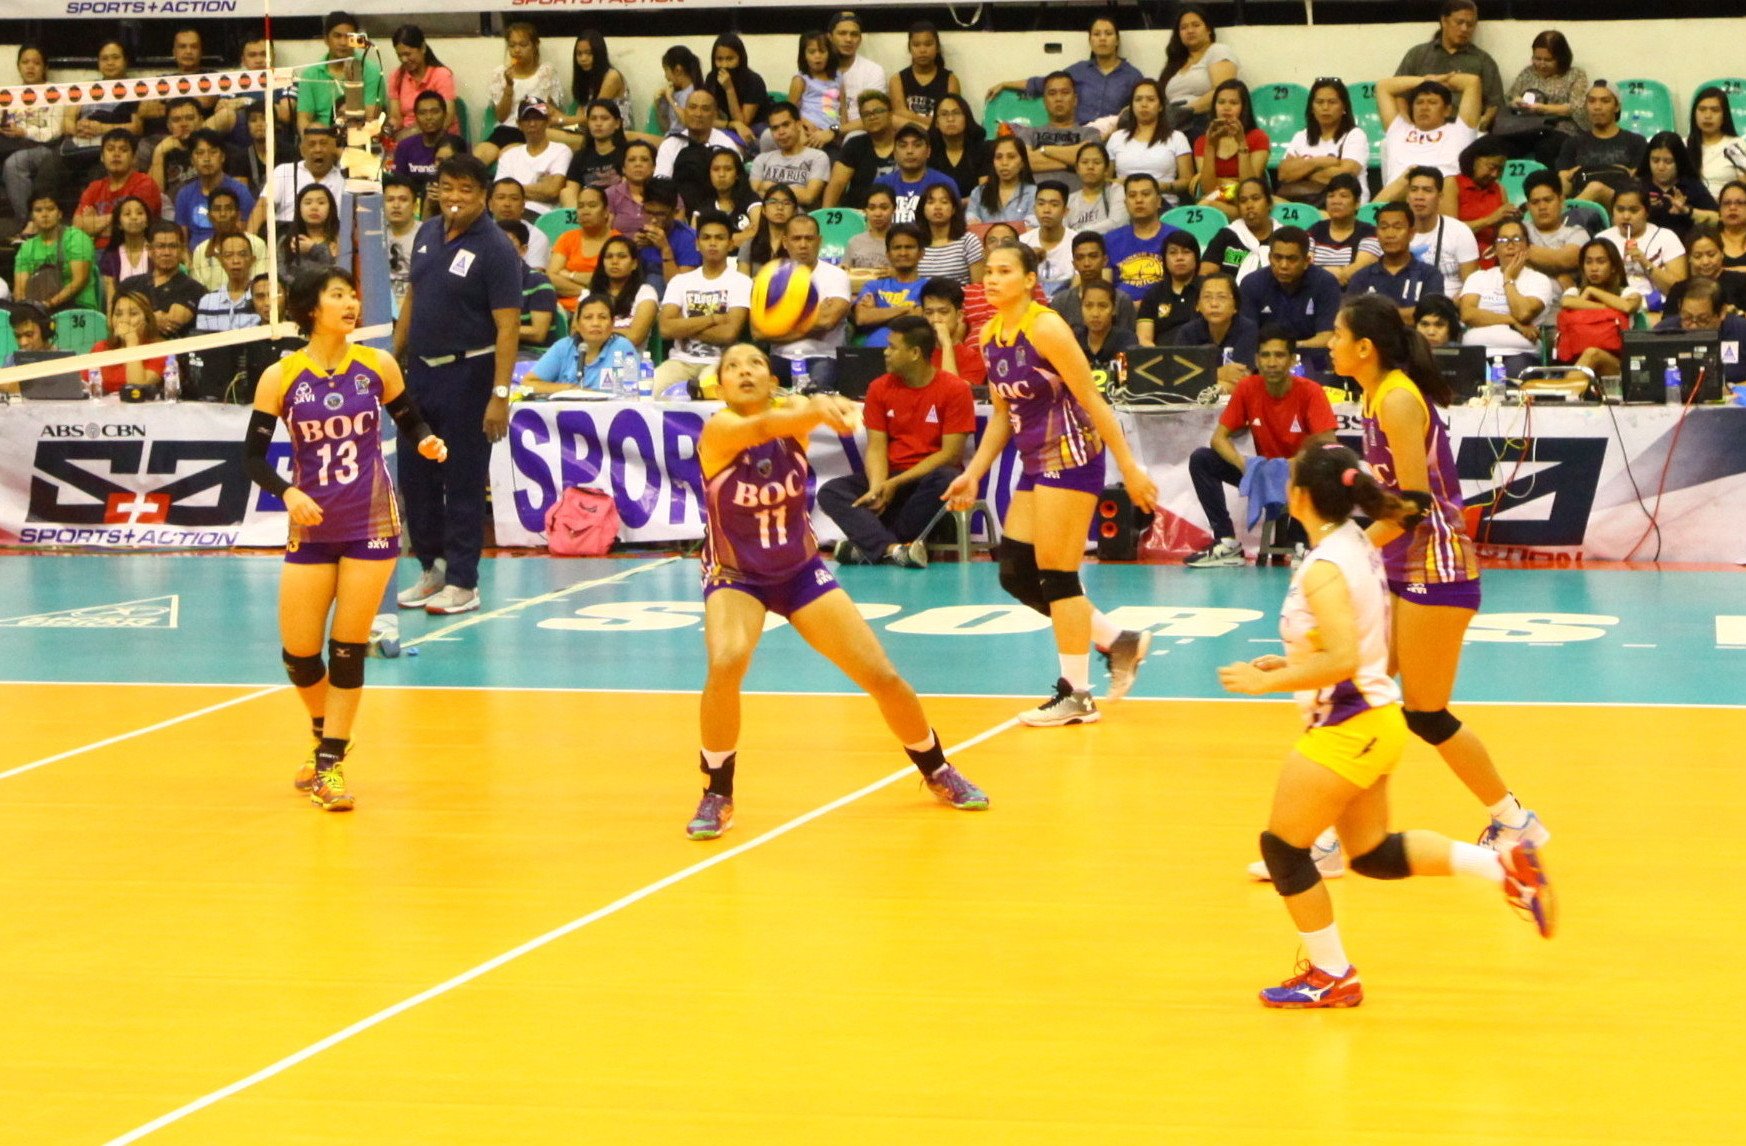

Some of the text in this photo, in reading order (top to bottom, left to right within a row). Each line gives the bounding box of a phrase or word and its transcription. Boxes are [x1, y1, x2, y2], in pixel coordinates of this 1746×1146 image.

[1509, 163, 1525, 176] 22
[826, 211, 843, 225] 29
[1186, 209, 1204, 224] 25
[1282, 207, 1299, 221] 24
[71, 314, 86, 329] 36
[297, 410, 374, 443] BOC
[316, 439, 359, 487] 13
[732, 469, 803, 508] BOC
[754, 504, 788, 549] 11
